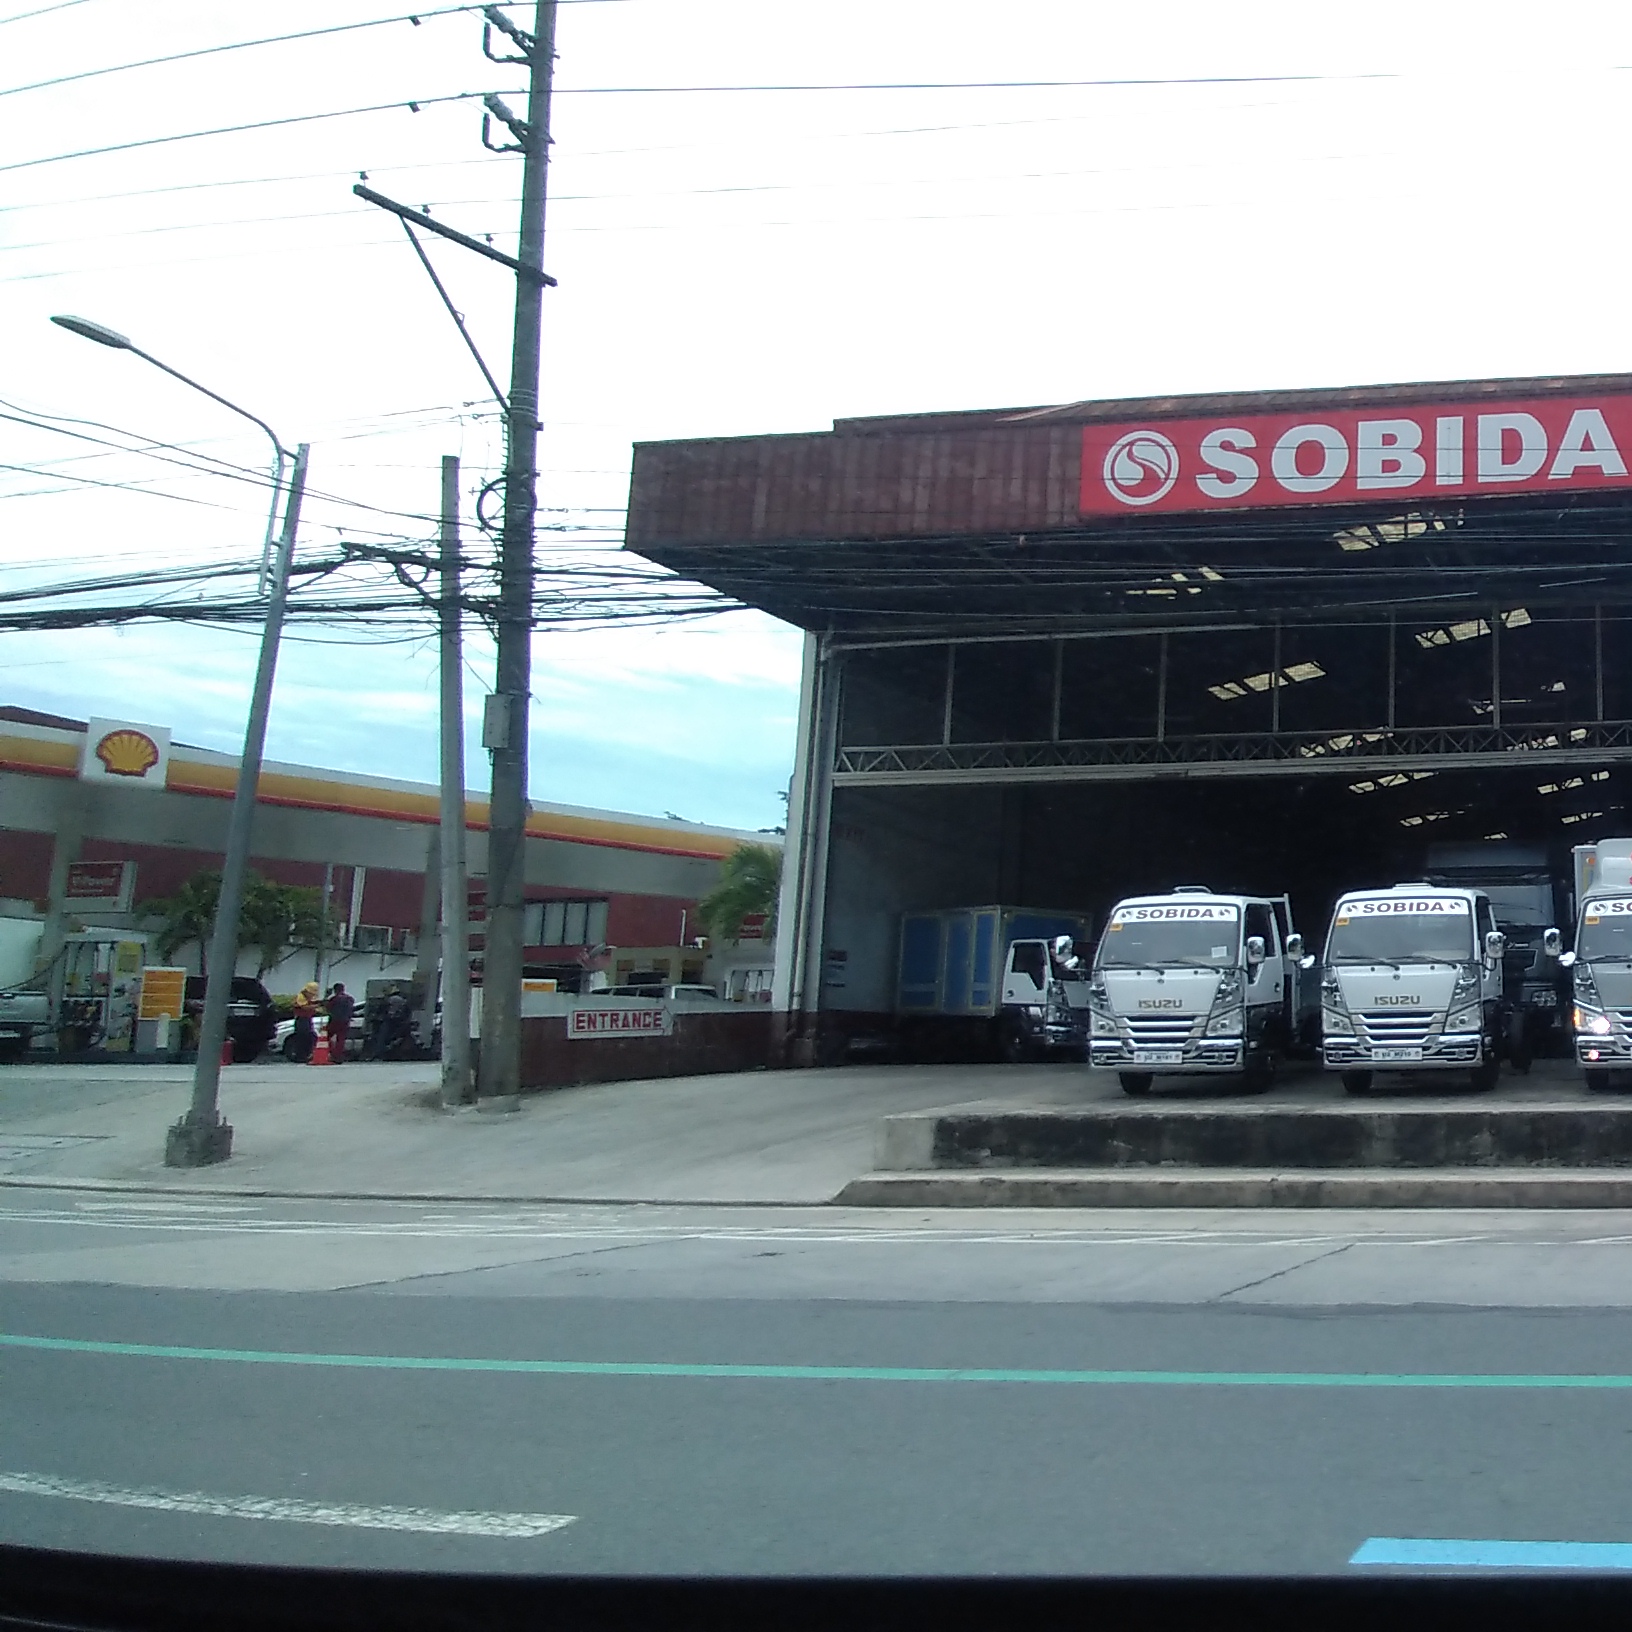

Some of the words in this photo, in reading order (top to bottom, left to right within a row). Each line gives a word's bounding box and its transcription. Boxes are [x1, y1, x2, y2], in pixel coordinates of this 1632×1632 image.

[1195, 408, 1630, 499] SOBIDA
[1135, 908, 1214, 919] SOBIDA
[1362, 901, 1444, 914] SOBIDA
[1138, 999, 1183, 1009] ISUZU
[1374, 995, 1421, 1006] ISUZU
[576, 1011, 662, 1030] ENTRANCE
